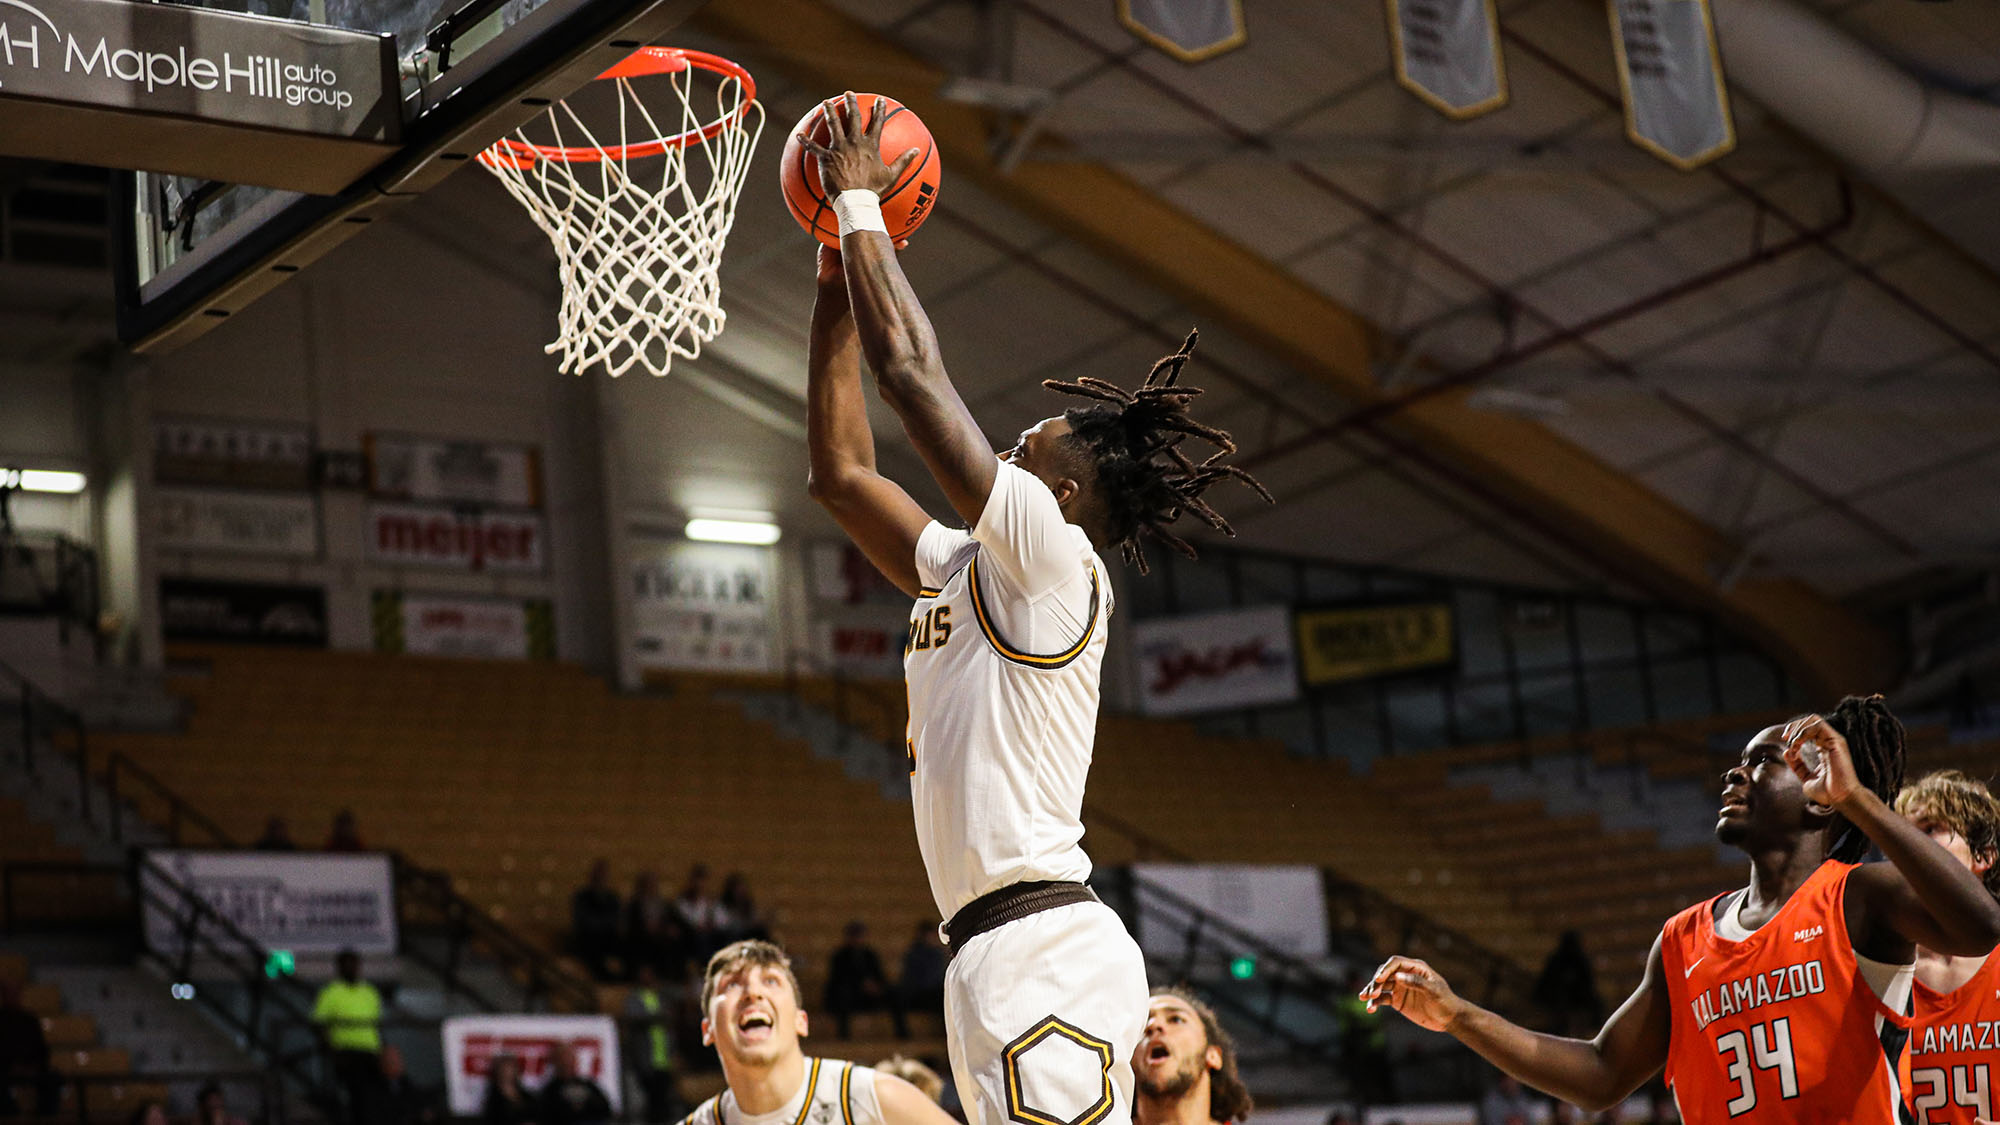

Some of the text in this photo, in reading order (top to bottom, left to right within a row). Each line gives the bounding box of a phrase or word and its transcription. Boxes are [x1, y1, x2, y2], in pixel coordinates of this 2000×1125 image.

[284, 64, 336, 86] auto
[285, 84, 353, 110] group
[377, 513, 535, 571] meijer
[1793, 925, 1823, 942] MIAA
[1691, 960, 1825, 1032] KALAMAZOO
[1716, 1016, 1799, 1118] 34
[1912, 1064, 1993, 1125] 24
